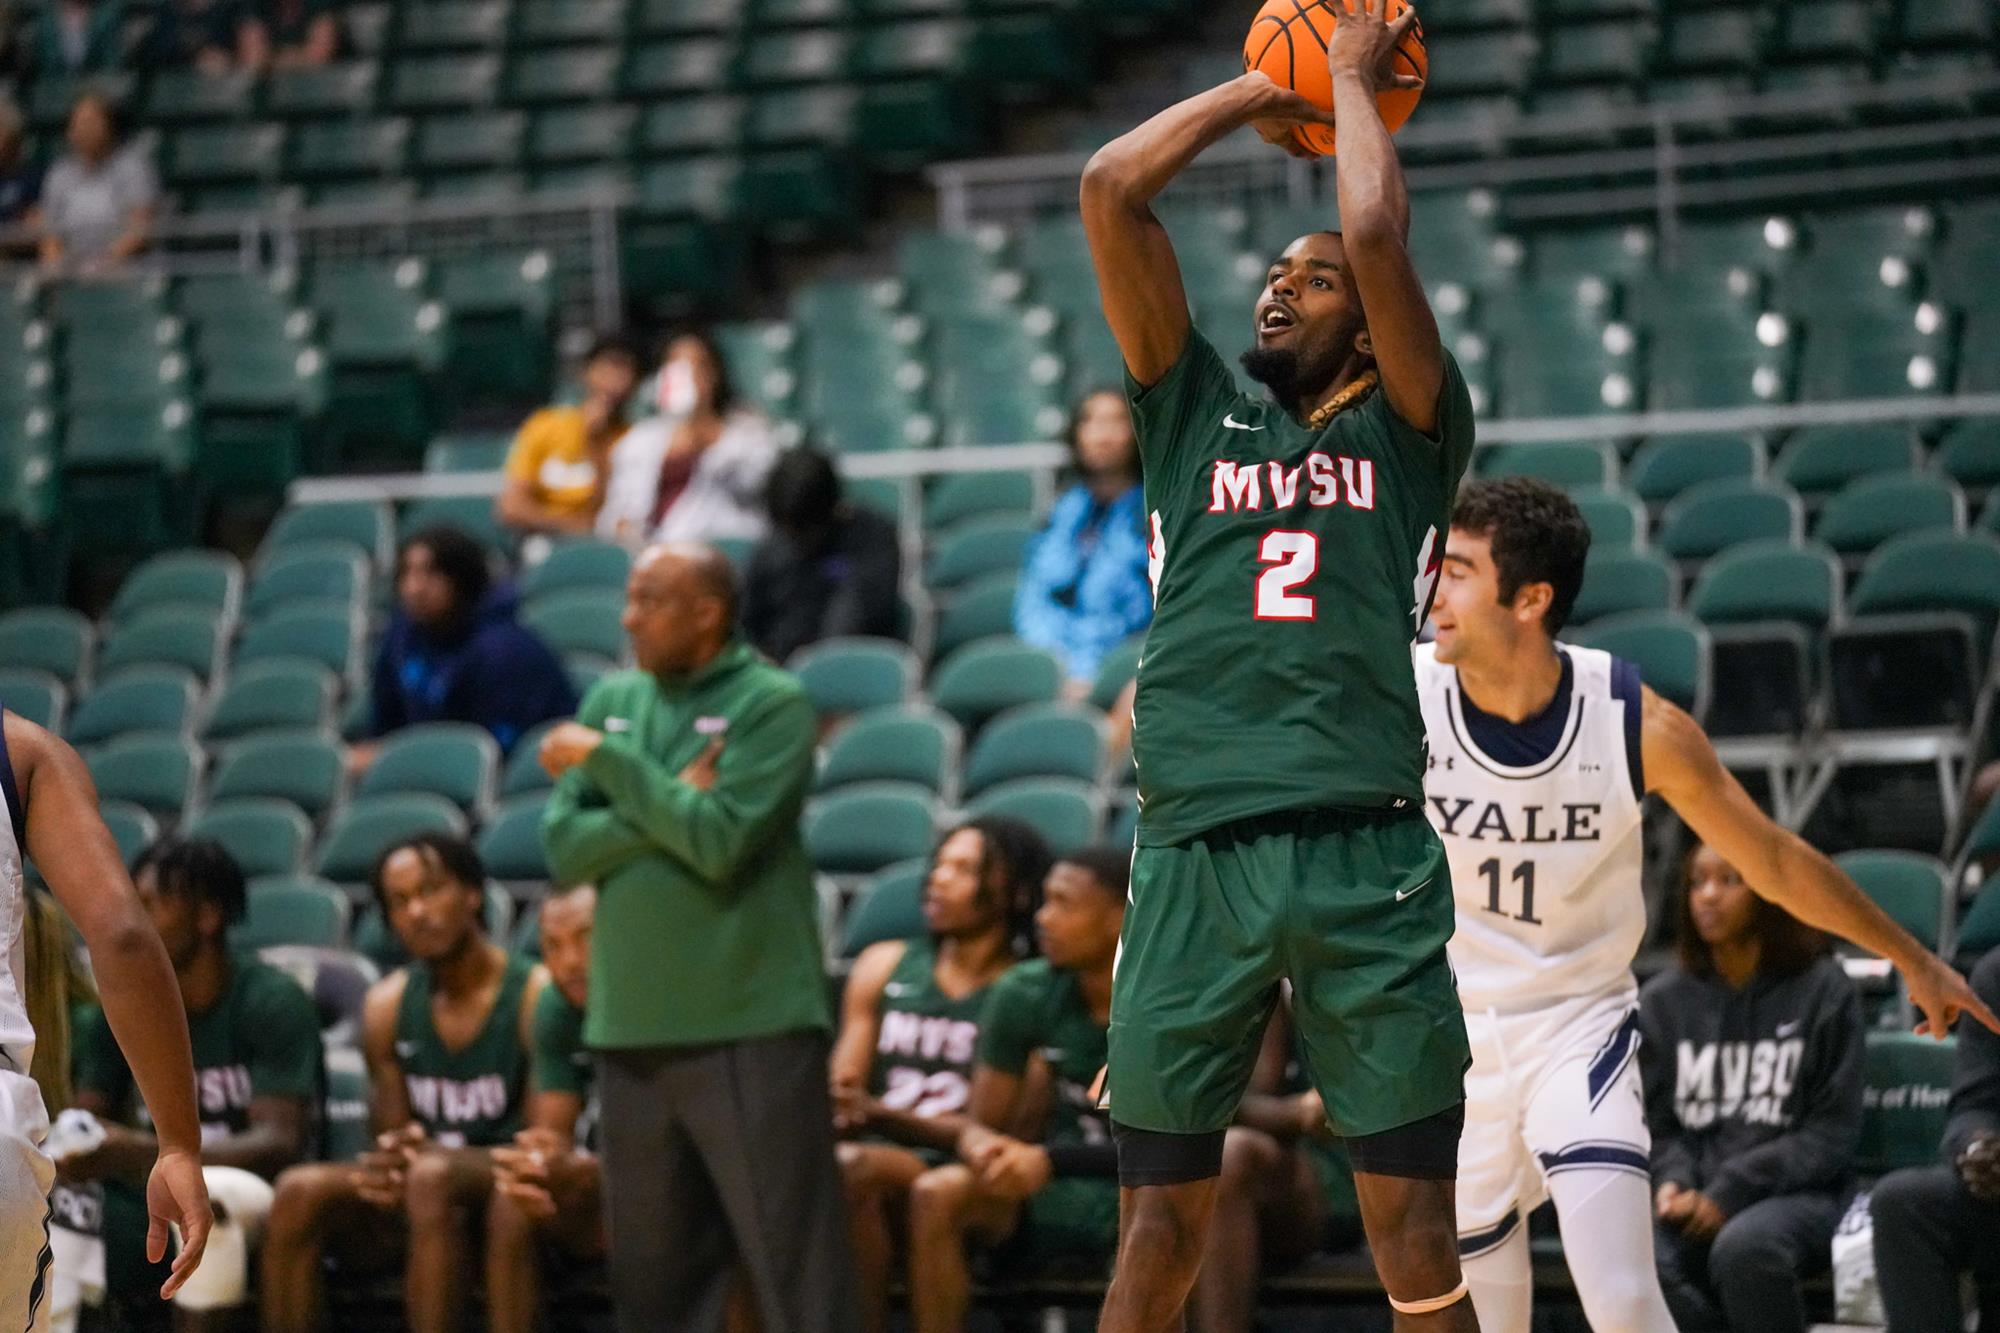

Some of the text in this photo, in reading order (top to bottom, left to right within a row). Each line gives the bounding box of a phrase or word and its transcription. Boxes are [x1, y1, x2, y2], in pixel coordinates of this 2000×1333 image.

[1207, 452, 1376, 513] MVSU
[1254, 528, 1319, 621] 2
[1428, 795, 1601, 844] YALE
[1478, 857, 1543, 926] 11
[1676, 1038, 1804, 1100] MVSU
